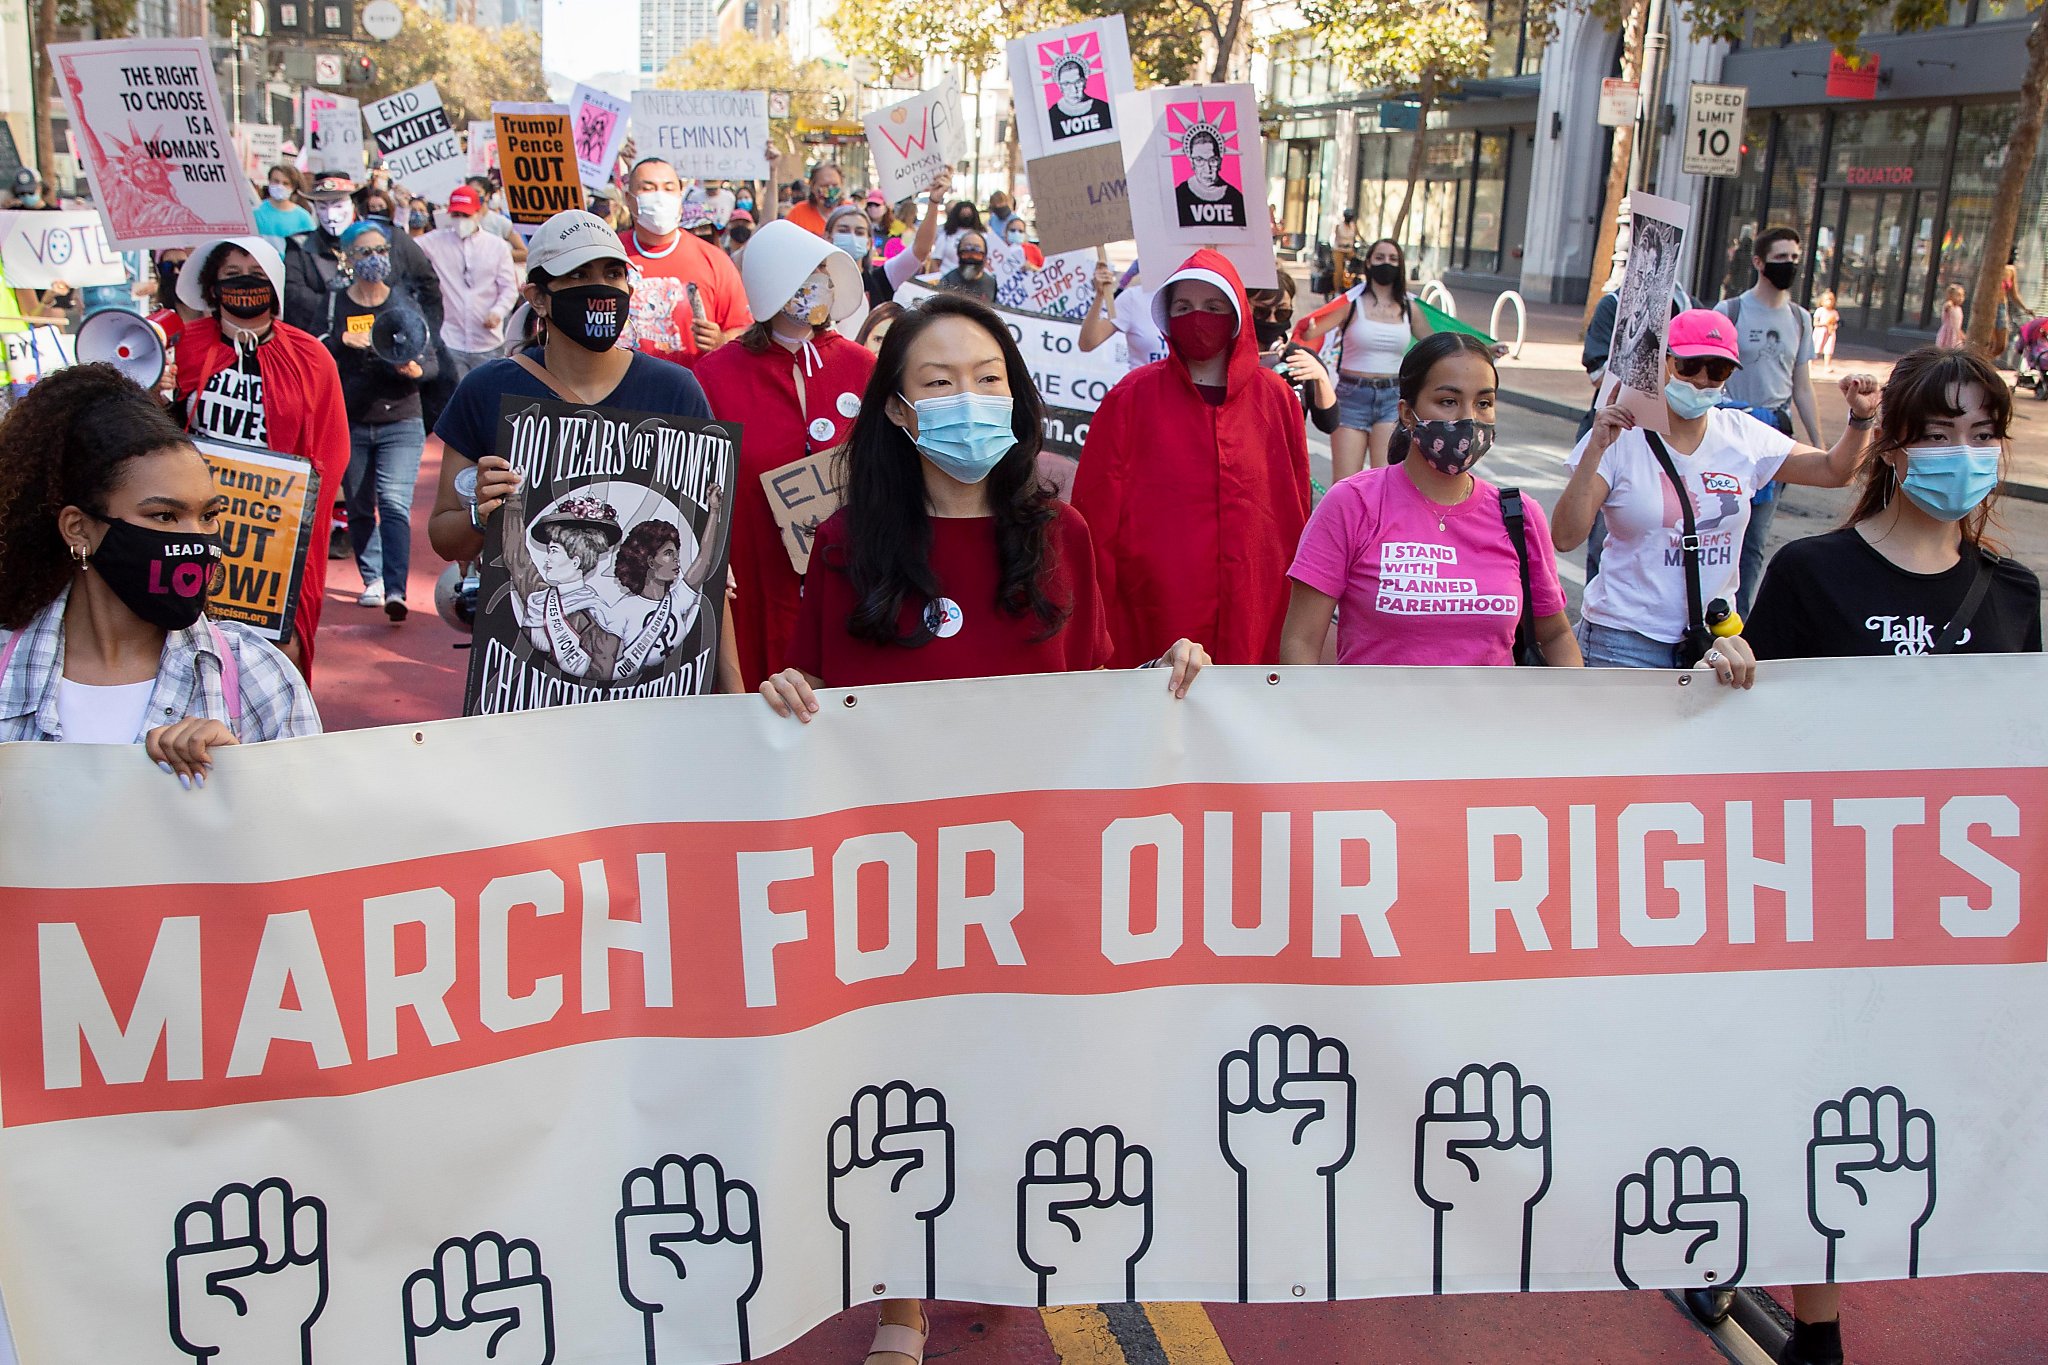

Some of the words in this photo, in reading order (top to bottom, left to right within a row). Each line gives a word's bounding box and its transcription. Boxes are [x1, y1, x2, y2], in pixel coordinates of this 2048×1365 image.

[122, 67, 153, 86] THE
[155, 66, 200, 86] RIGHT
[120, 93, 142, 111] TO
[144, 92, 207, 111] CHOOSE
[377, 92, 419, 121] END
[642, 92, 761, 118] INTERSECTIONAL
[1695, 93, 1741, 107] SPEED
[186, 116, 200, 135] IS
[203, 116, 214, 135] A
[501, 116, 563, 134] Trump/
[1060, 113, 1100, 136] VOTE
[1697, 111, 1735, 123] LIMIT
[377, 112, 448, 151] WHITE
[659, 125, 750, 149] FEMINISM
[1698, 128, 1730, 156] 10
[144, 140, 220, 159] WOMAN'S
[508, 135, 563, 153] Pence
[387, 137, 459, 181] SILENCE
[514, 156, 564, 182] OUT
[674, 152, 756, 174] atters
[895, 152, 942, 180] WOMXN
[183, 164, 227, 182] RIGHT
[1847, 166, 1914, 184] EQUATOR
[509, 185, 579, 211] NOW!
[1087, 178, 1129, 206] LAW
[1190, 204, 1234, 223] VOTE
[559, 223, 581, 241] slay
[583, 222, 612, 238] queen
[22, 226, 121, 265] VOTE
[1032, 259, 1065, 291] STOP
[587, 298, 617, 312] VOTE
[586, 311, 617, 325] VOTE
[584, 323, 616, 338] VOTE
[1041, 331, 1072, 353] to
[204, 371, 264, 405] BLAC
[1071, 379, 1115, 402] CO
[510, 415, 550, 489] 100
[553, 416, 629, 483] YEARS
[632, 433, 653, 471] OF
[656, 427, 731, 512] WOMEN
[1710, 479, 1736, 489] Dee
[219, 494, 282, 523] ence
[164, 543, 205, 556] LEAD
[222, 520, 275, 562] UT
[1670, 532, 1731, 548] WEN'S
[1384, 545, 1390, 558] I
[1395, 545, 1453, 560] STAND
[1664, 546, 1731, 567] MRCH
[148, 559, 217, 597] LOV
[1384, 562, 1434, 575] WITH
[208, 563, 282, 607] OW!
[1381, 578, 1473, 594] PLANNED
[549, 593, 559, 617] VOTES
[1378, 595, 1516, 612] PARENTHOOD
[552, 617, 562, 634] FOR
[1865, 615, 1935, 648] Talk
[557, 632, 586, 673] WOMEN
[617, 658, 636, 678] OUR
[631, 632, 654, 660] FIGHT
[651, 611, 667, 634] GOES
[38, 853, 674, 1090] MARCH
[736, 820, 1026, 1007] FOR
[1101, 810, 1401, 966] OUR
[1466, 795, 2021, 955] RIGHTS
